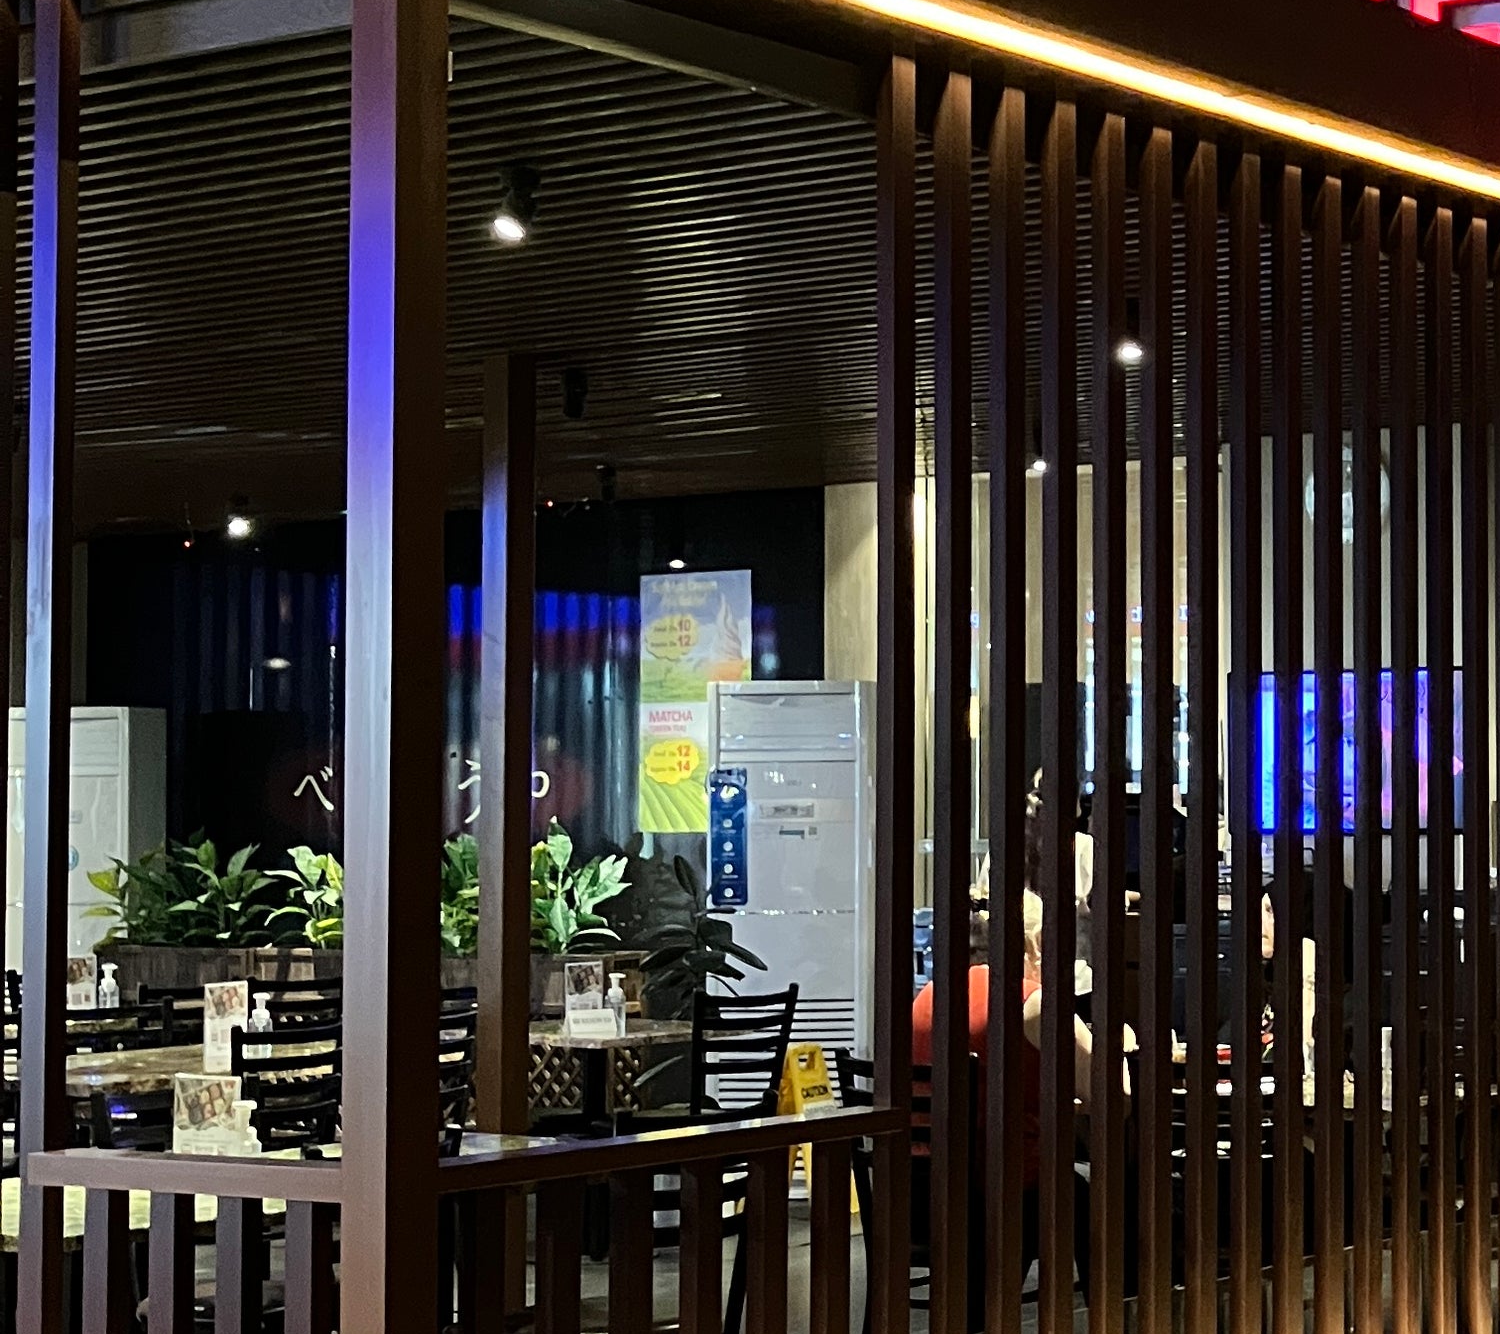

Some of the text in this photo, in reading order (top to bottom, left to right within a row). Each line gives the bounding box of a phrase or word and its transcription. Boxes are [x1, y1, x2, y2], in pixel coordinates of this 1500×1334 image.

[648, 710, 694, 724] MATCHA
[677, 745, 691, 757] 12
[677, 760, 691, 772] 14
